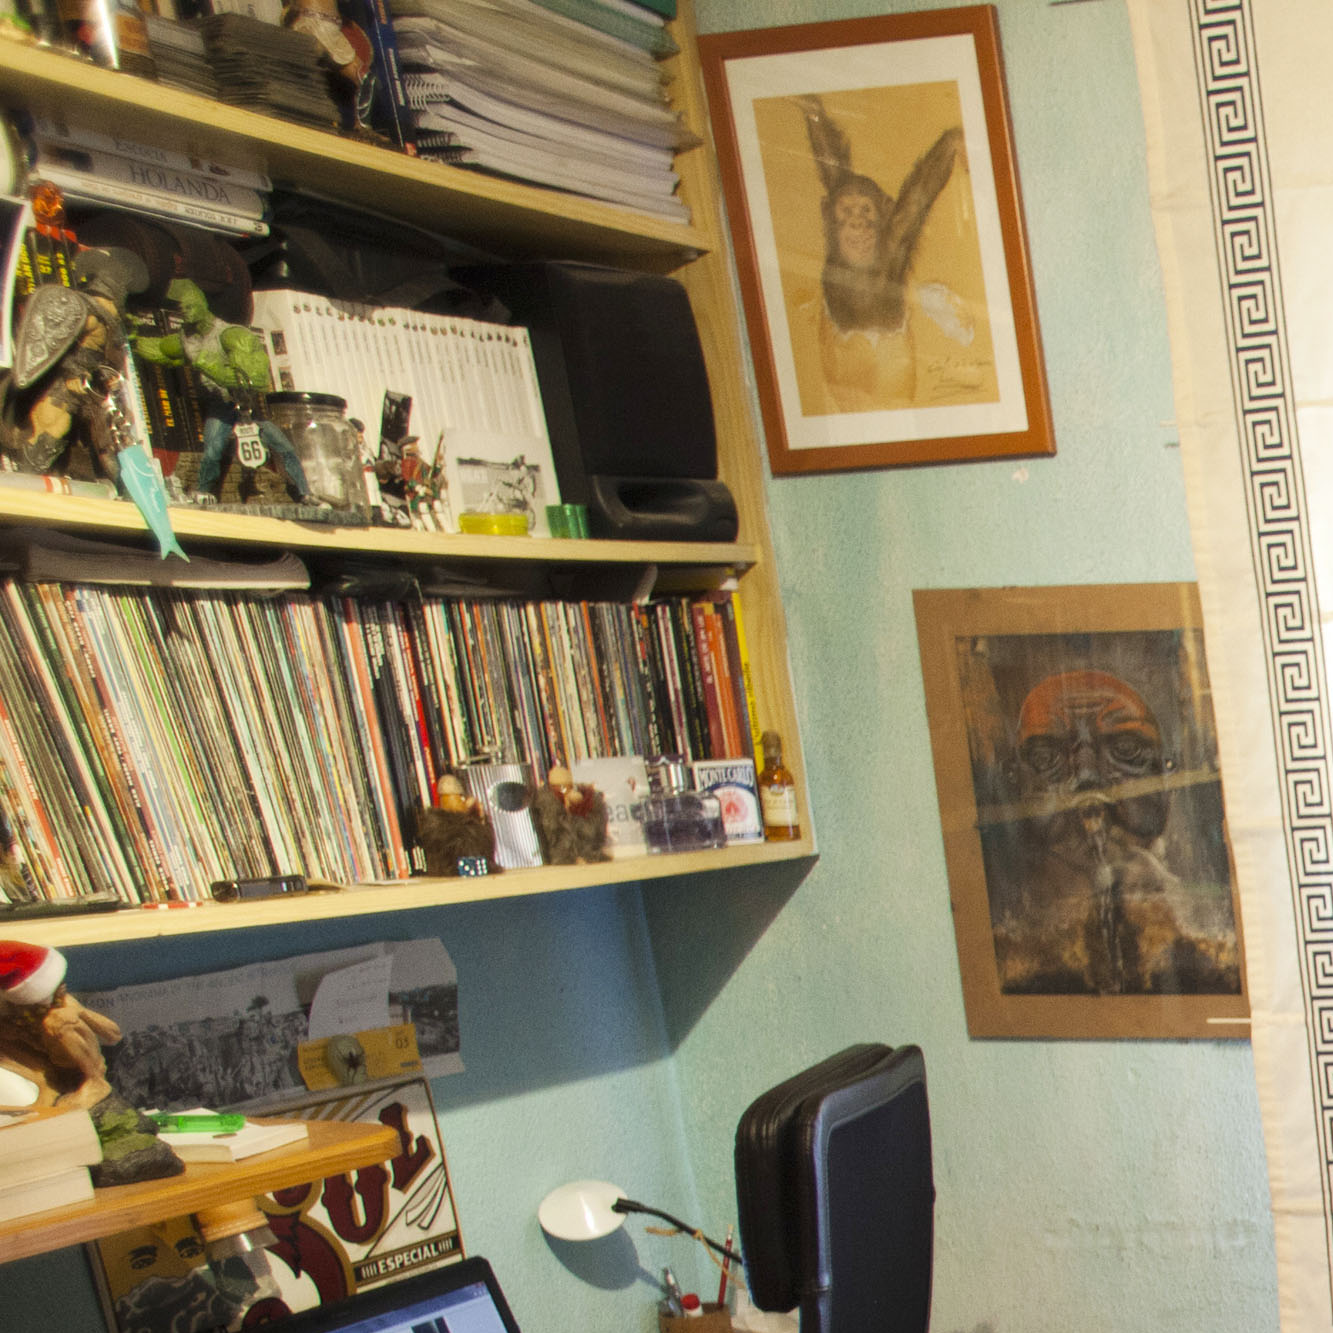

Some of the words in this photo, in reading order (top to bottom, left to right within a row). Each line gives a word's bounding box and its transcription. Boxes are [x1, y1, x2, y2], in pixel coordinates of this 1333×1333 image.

[129, 164, 231, 205] HOLANDA
[241, 440, 263, 461] 66
[377, 1242, 440, 1275] ESPECIAL
